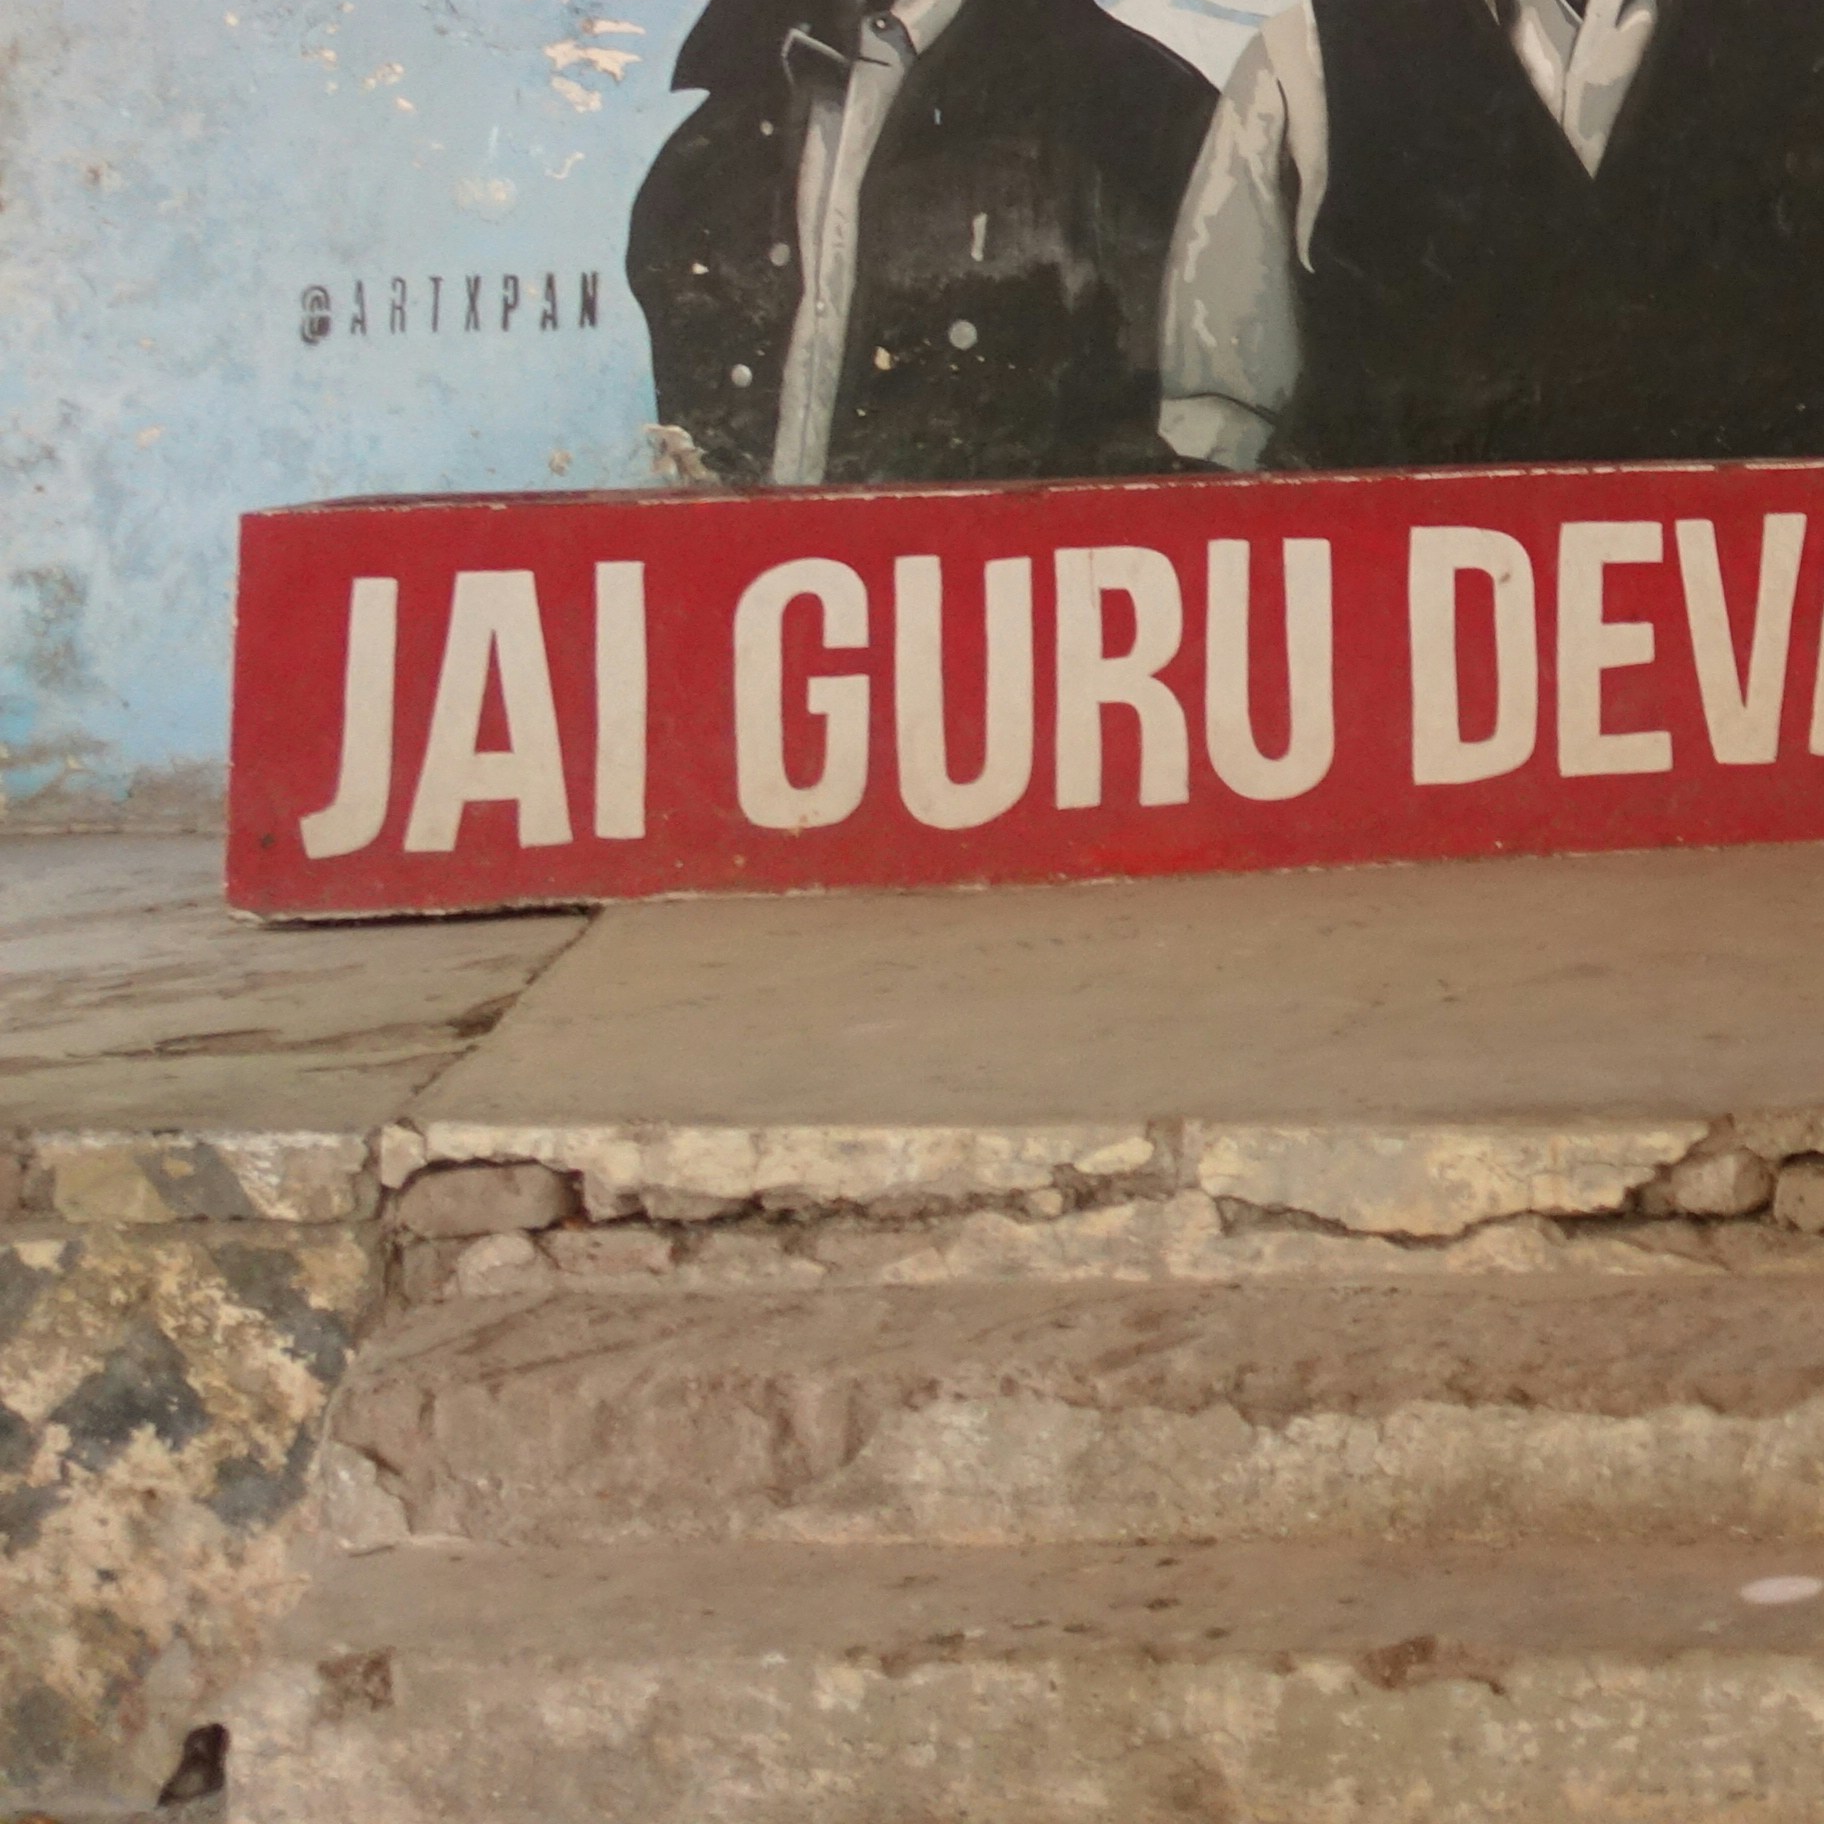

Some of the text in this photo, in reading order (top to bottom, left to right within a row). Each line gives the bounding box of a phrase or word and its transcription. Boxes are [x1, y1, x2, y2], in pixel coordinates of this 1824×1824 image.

[298, 270, 600, 347] @ARTXPAN
[299, 560, 648, 859] JAI
[733, 538, 1335, 834] GURU
